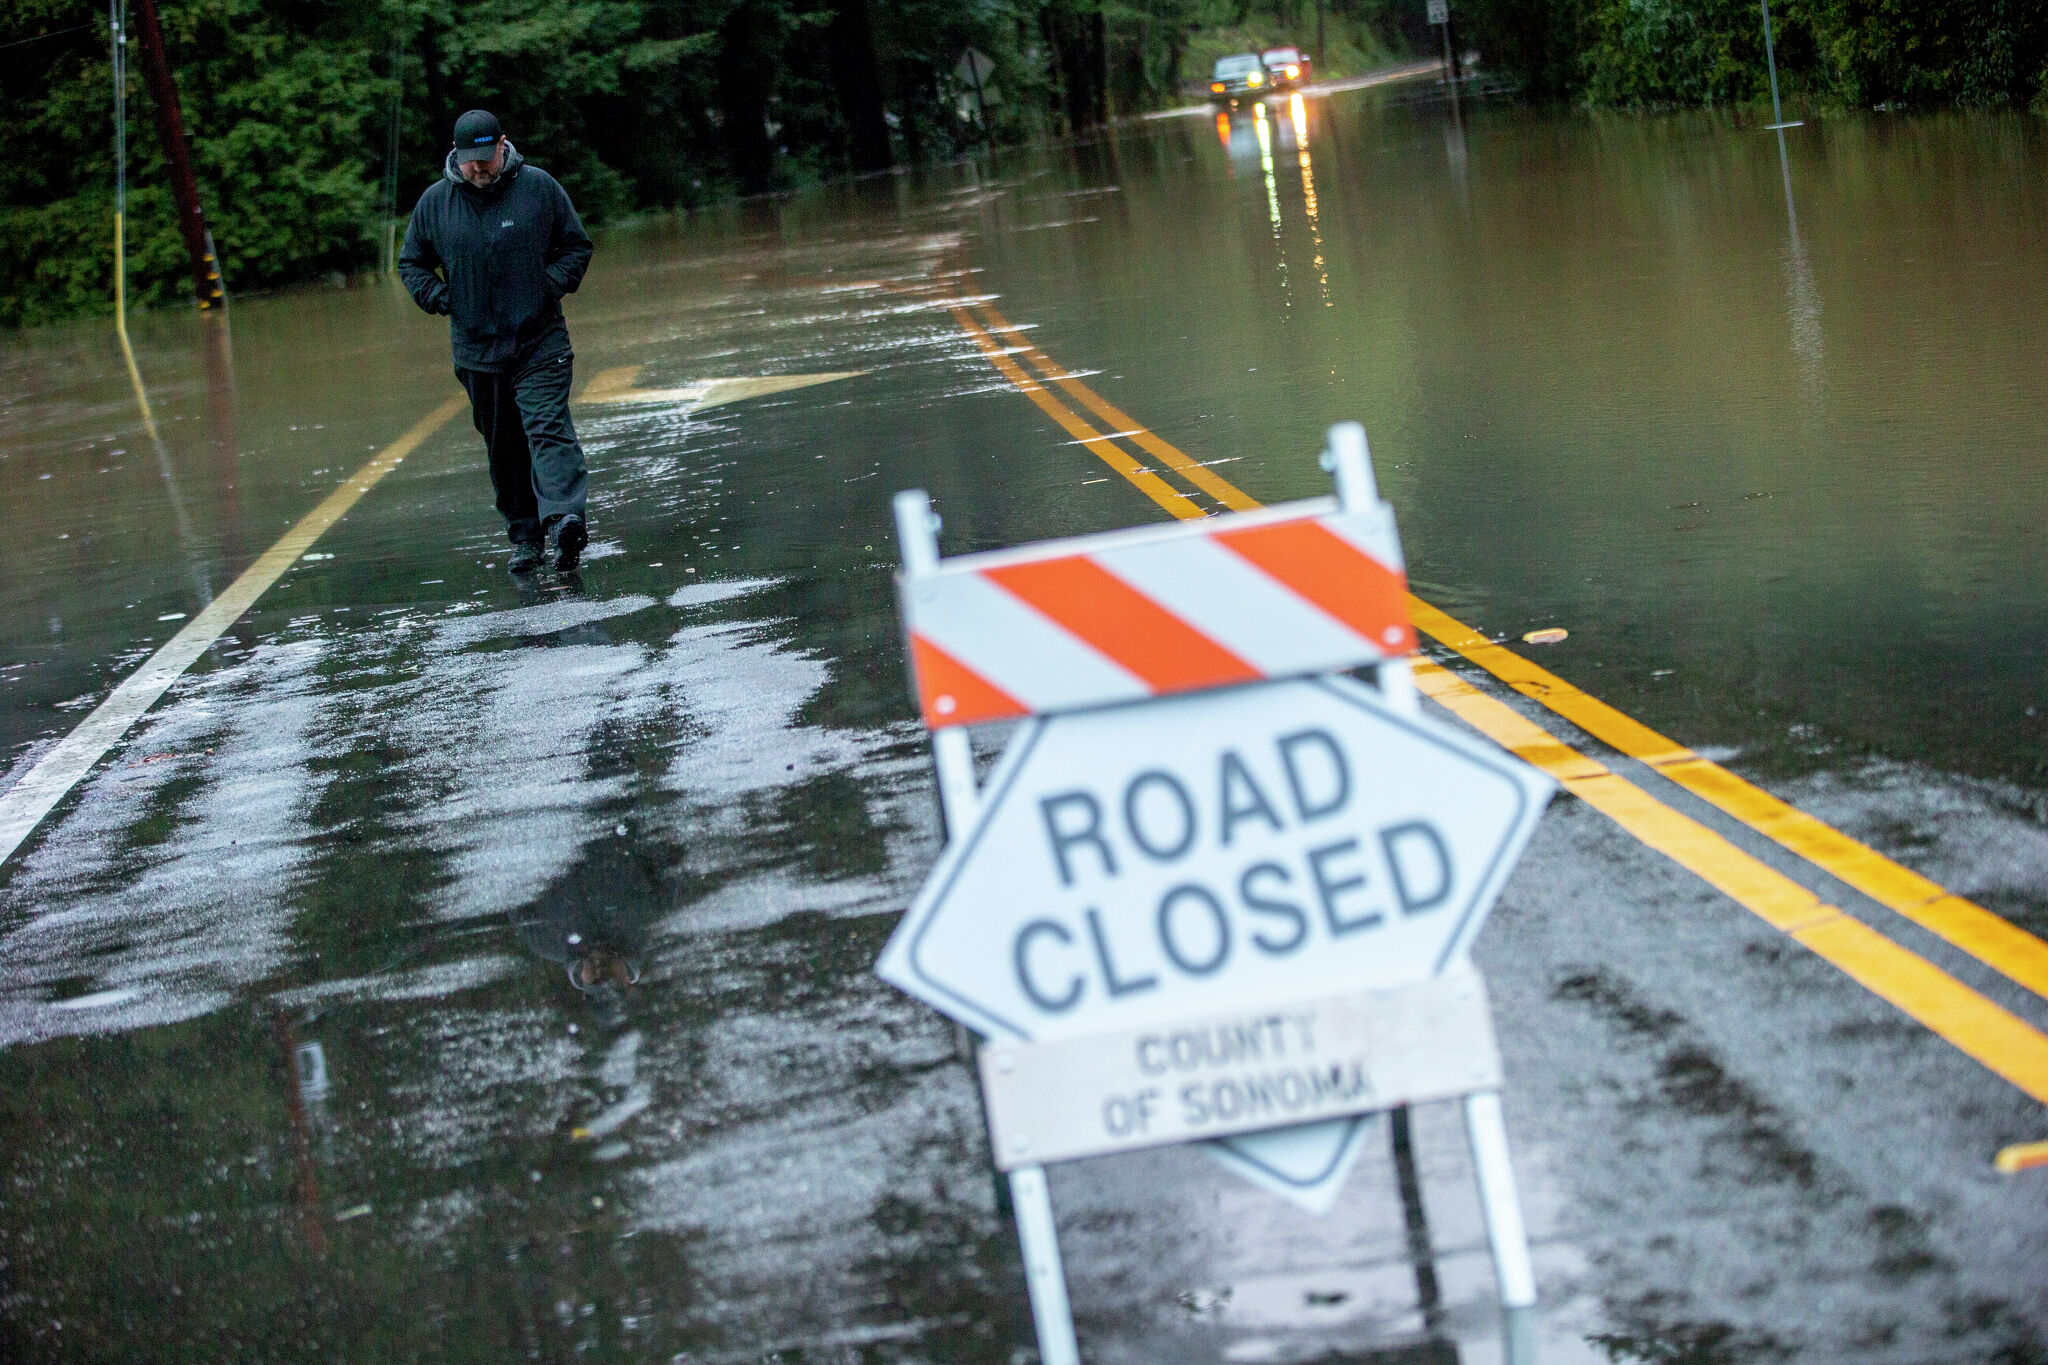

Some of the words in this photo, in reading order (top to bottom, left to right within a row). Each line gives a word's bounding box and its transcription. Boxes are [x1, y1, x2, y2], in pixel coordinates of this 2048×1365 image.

[1038, 727, 1352, 888] ROAD
[1012, 819, 1455, 1015] CLOSED
[1103, 1087, 1157, 1136] OF
[1179, 1061, 1373, 1126] SONOMA
[1136, 1014, 1317, 1076] COUNTY
